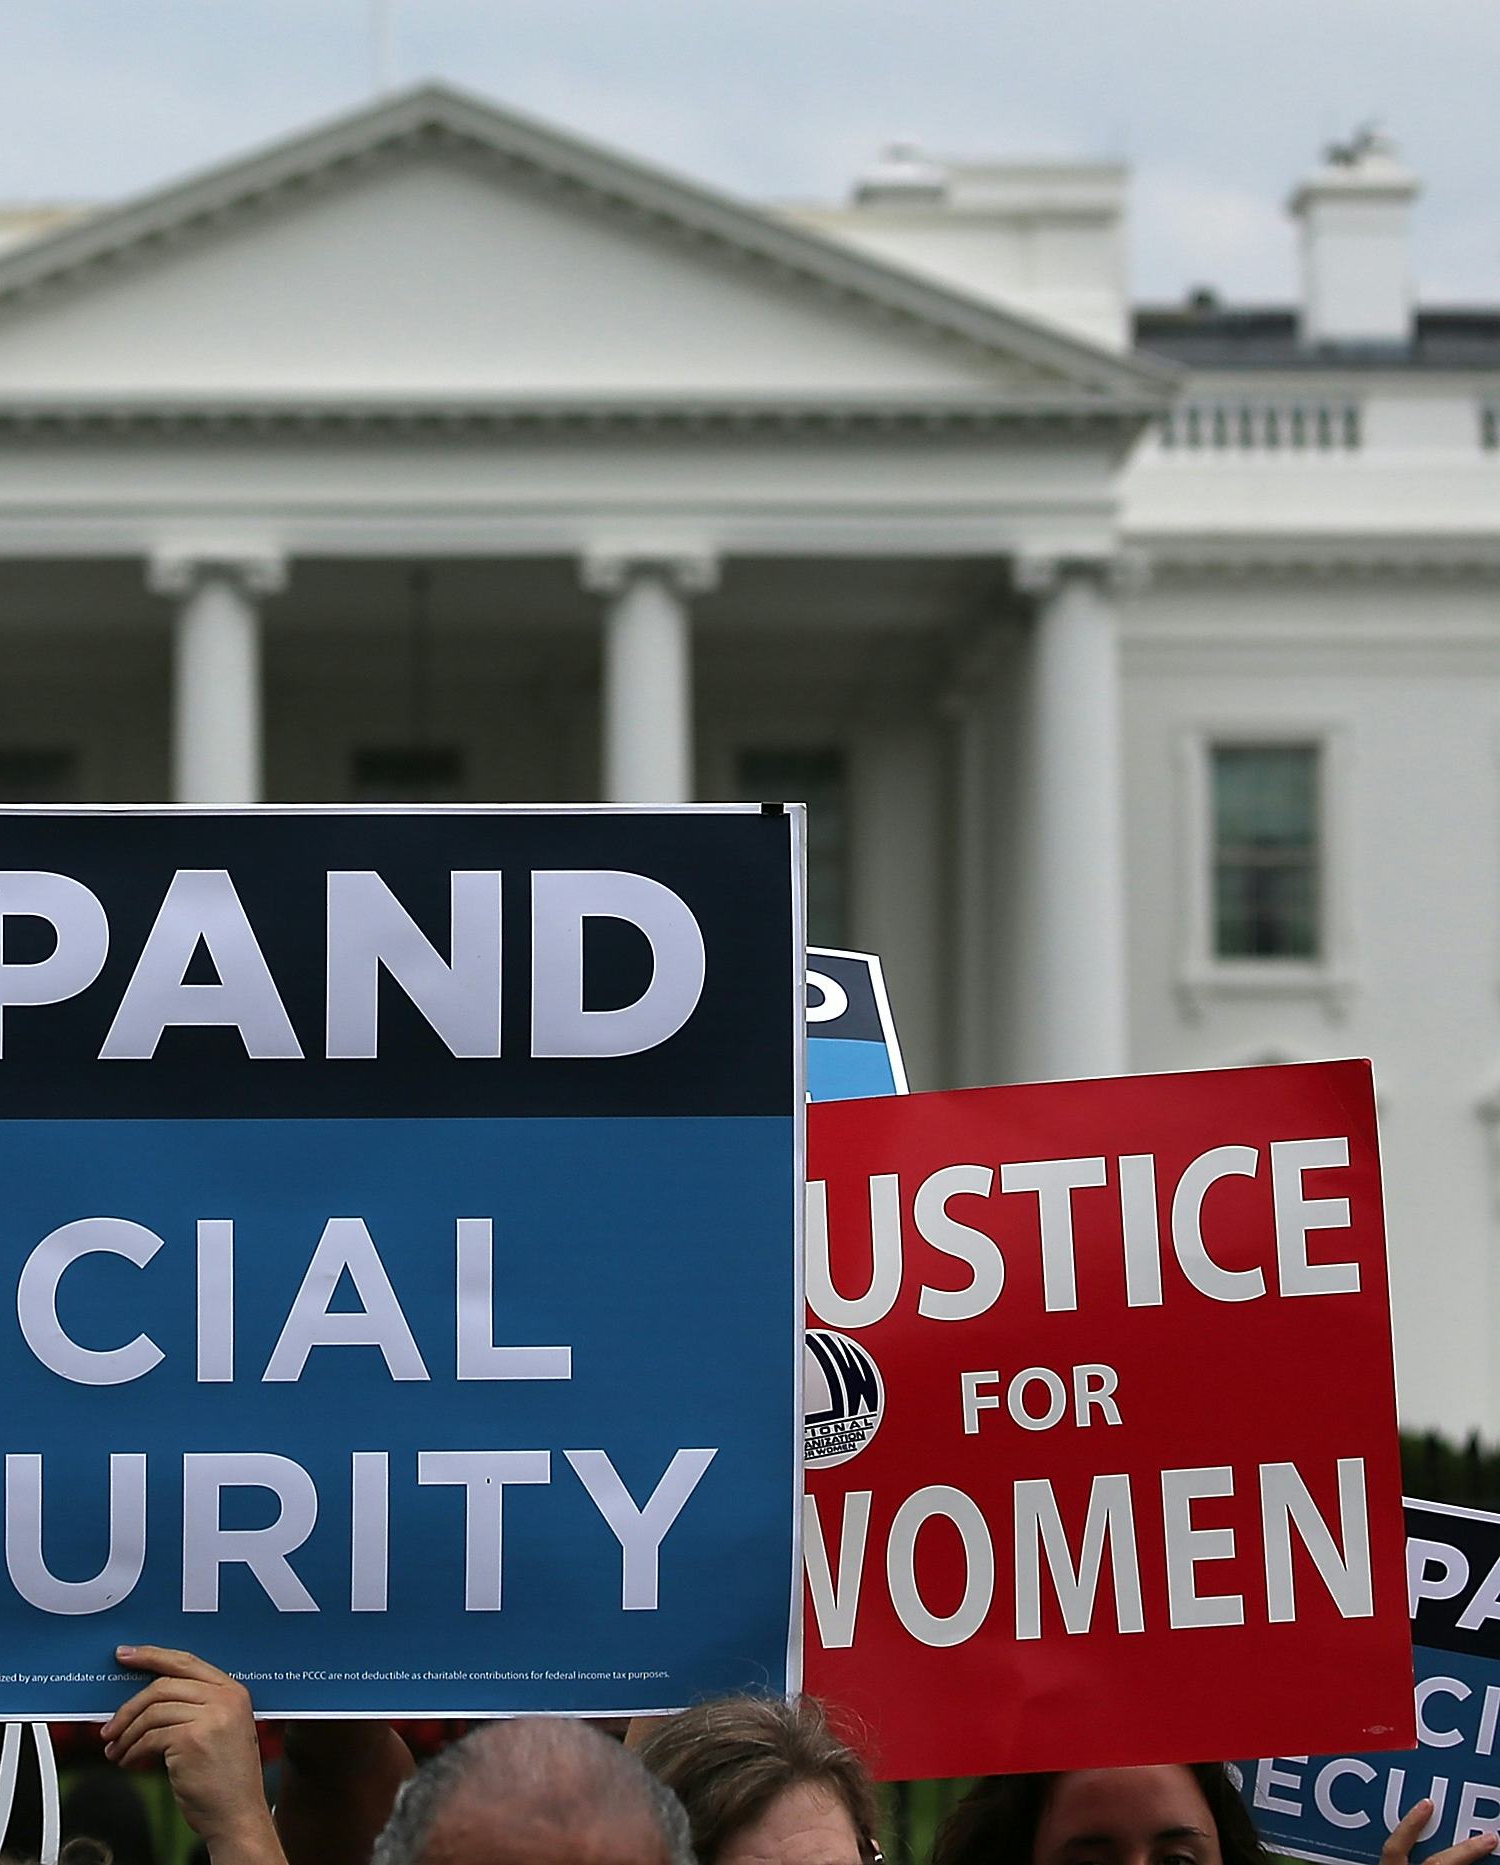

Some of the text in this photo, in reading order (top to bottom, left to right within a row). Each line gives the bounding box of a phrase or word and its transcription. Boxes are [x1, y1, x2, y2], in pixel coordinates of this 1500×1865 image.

[805, 1137, 1362, 1328] USTICE
[961, 1364, 1123, 1435] FOR
[804, 1418, 873, 1437] IONAL
[804, 1430, 866, 1450] ANIZATION
[18, 1673, 30, 1684] by
[31, 1674, 48, 1684] any
[50, 1672, 94, 1682] candidate
[96, 1674, 106, 1682] or
[274, 1672, 284, 1680] to
[285, 1671, 301, 1680] the
[302, 1671, 326, 1680] PCCC
[344, 1672, 360, 1680] not
[361, 1671, 410, 1680] deductible
[423, 1671, 468, 1680] charitable
[469, 1671, 529, 1680] contributions
[530, 1670, 543, 1680] for
[544, 1670, 576, 1680] federal
[577, 1671, 611, 1680] income
[612, 1671, 626, 1680] tax
[628, 1670, 670, 1681] purposes.
